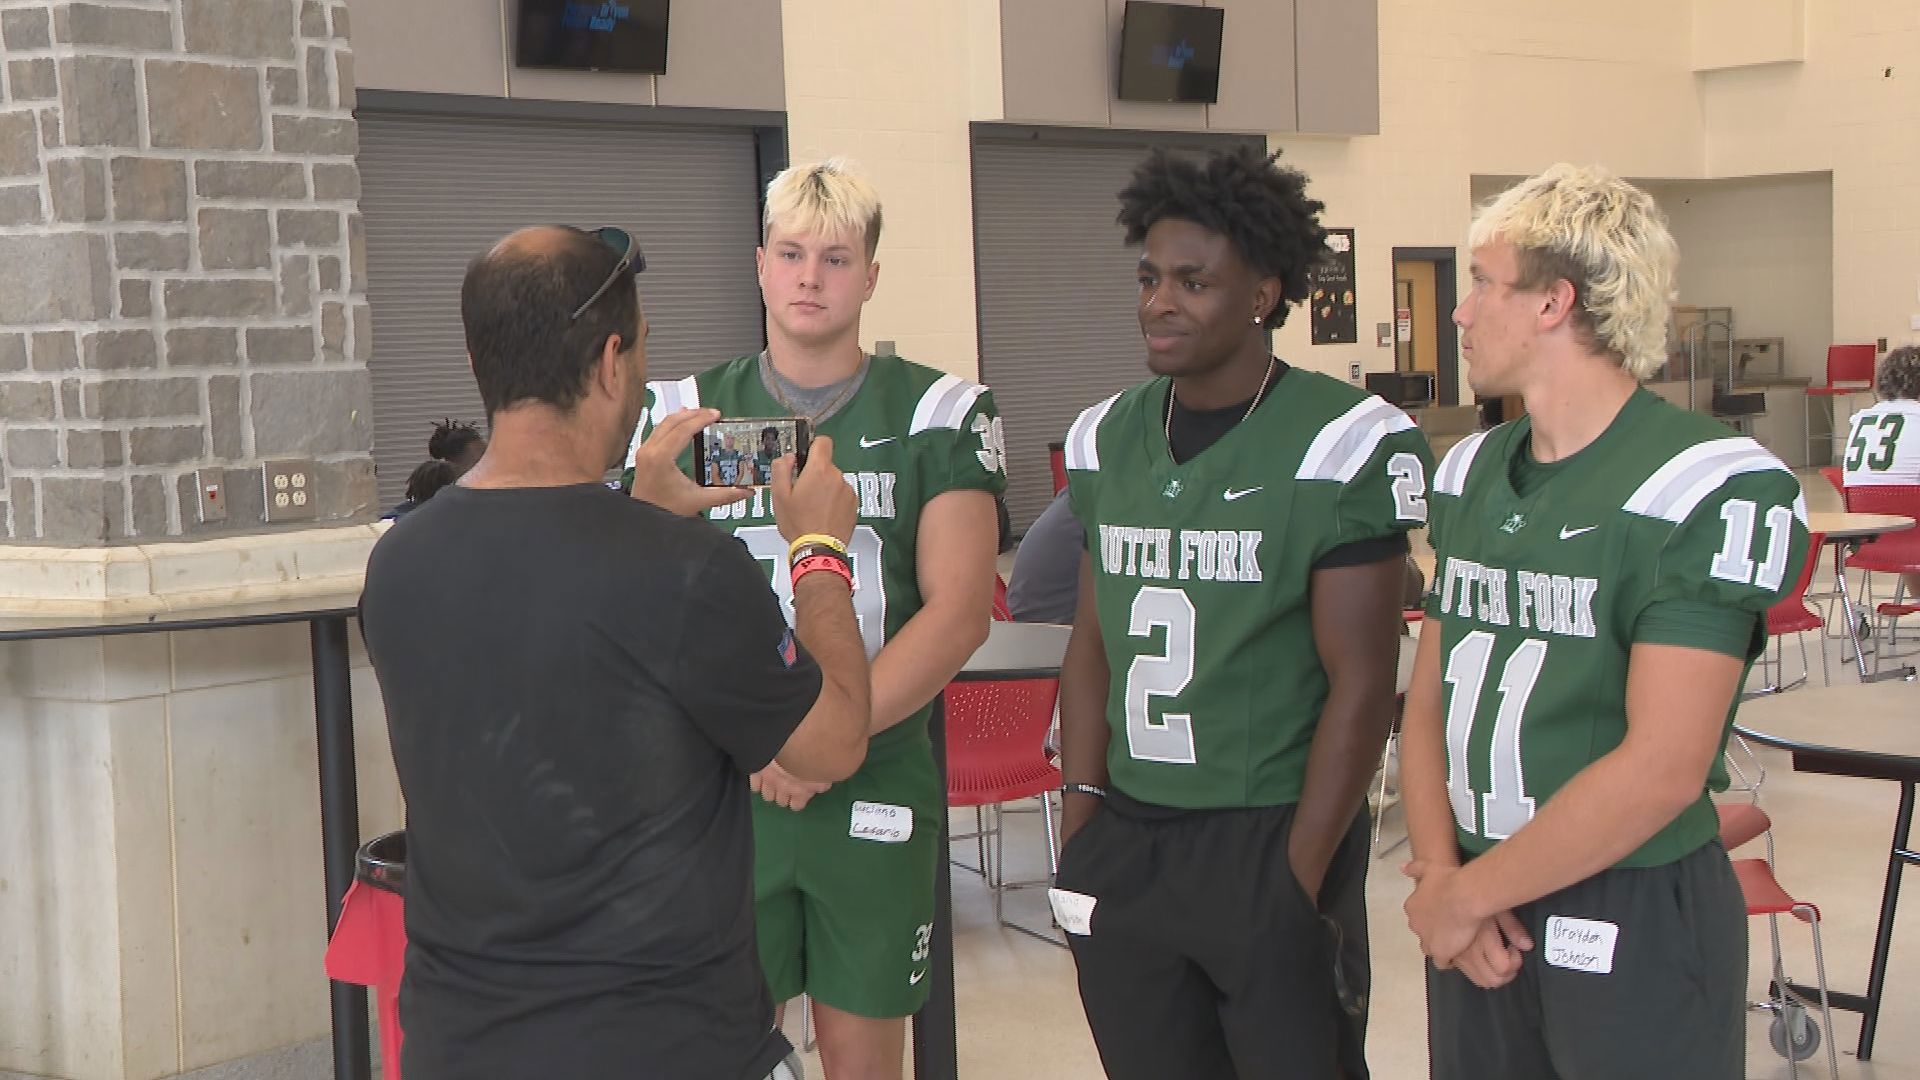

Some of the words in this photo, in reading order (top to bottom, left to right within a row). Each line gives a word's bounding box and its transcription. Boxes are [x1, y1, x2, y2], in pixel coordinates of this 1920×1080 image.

[1846, 414, 1905, 472] 53
[843, 471, 897, 519] RK
[1387, 452, 1428, 523] 2
[1177, 530, 1263, 582] FORK
[1709, 498, 1793, 592] 11
[1436, 557, 1511, 626] TCH
[1517, 570, 1598, 638] FORK
[1125, 585, 1197, 764] 2
[1444, 630, 1548, 840] 11
